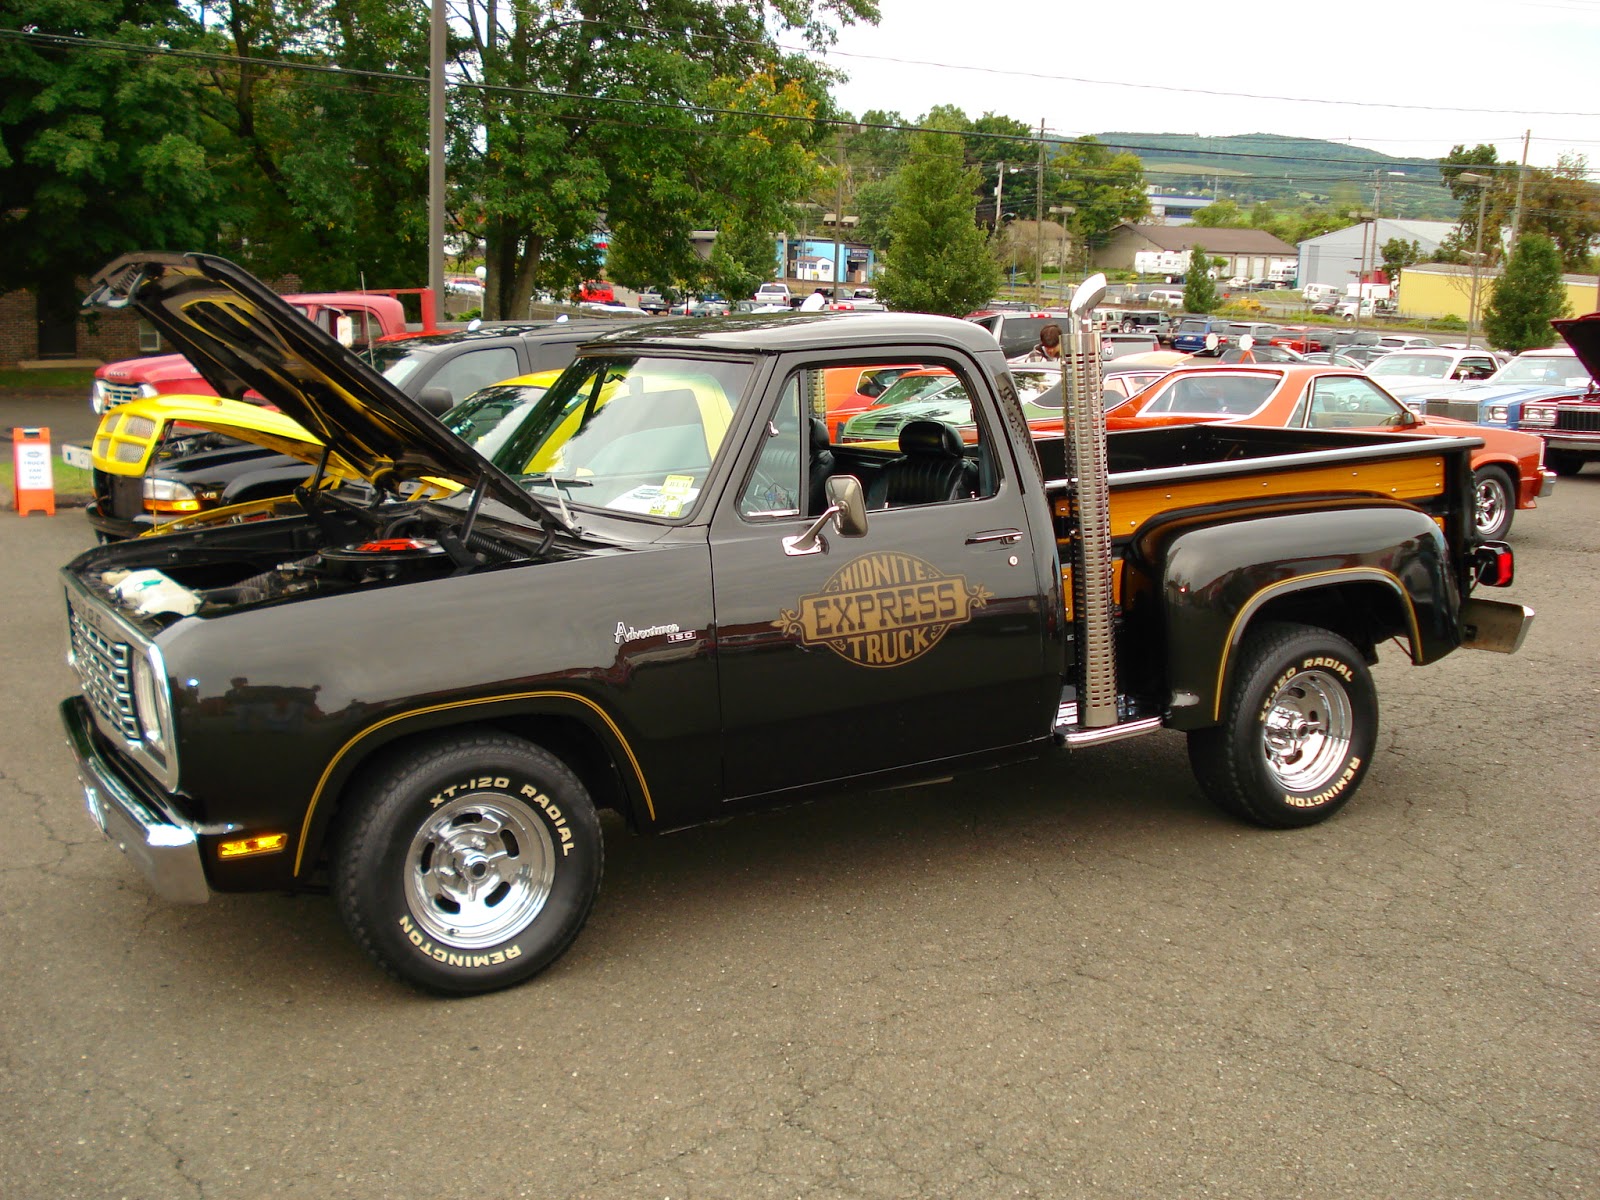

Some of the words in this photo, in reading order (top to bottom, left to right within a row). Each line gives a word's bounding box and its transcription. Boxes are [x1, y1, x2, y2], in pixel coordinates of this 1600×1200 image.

[840, 555, 927, 591] MIDNITE
[812, 583, 958, 633] EXPRESS
[669, 632, 693, 641] 150
[846, 629, 931, 665] TRUCK
[1259, 666, 1297, 723] XT-120
[1303, 657, 1354, 683] RADIAL
[1285, 756, 1362, 808] REMINGTON
[429, 776, 511, 808] XT-120
[520, 783, 576, 857] RADIAL
[399, 915, 523, 968] REMINGTON
